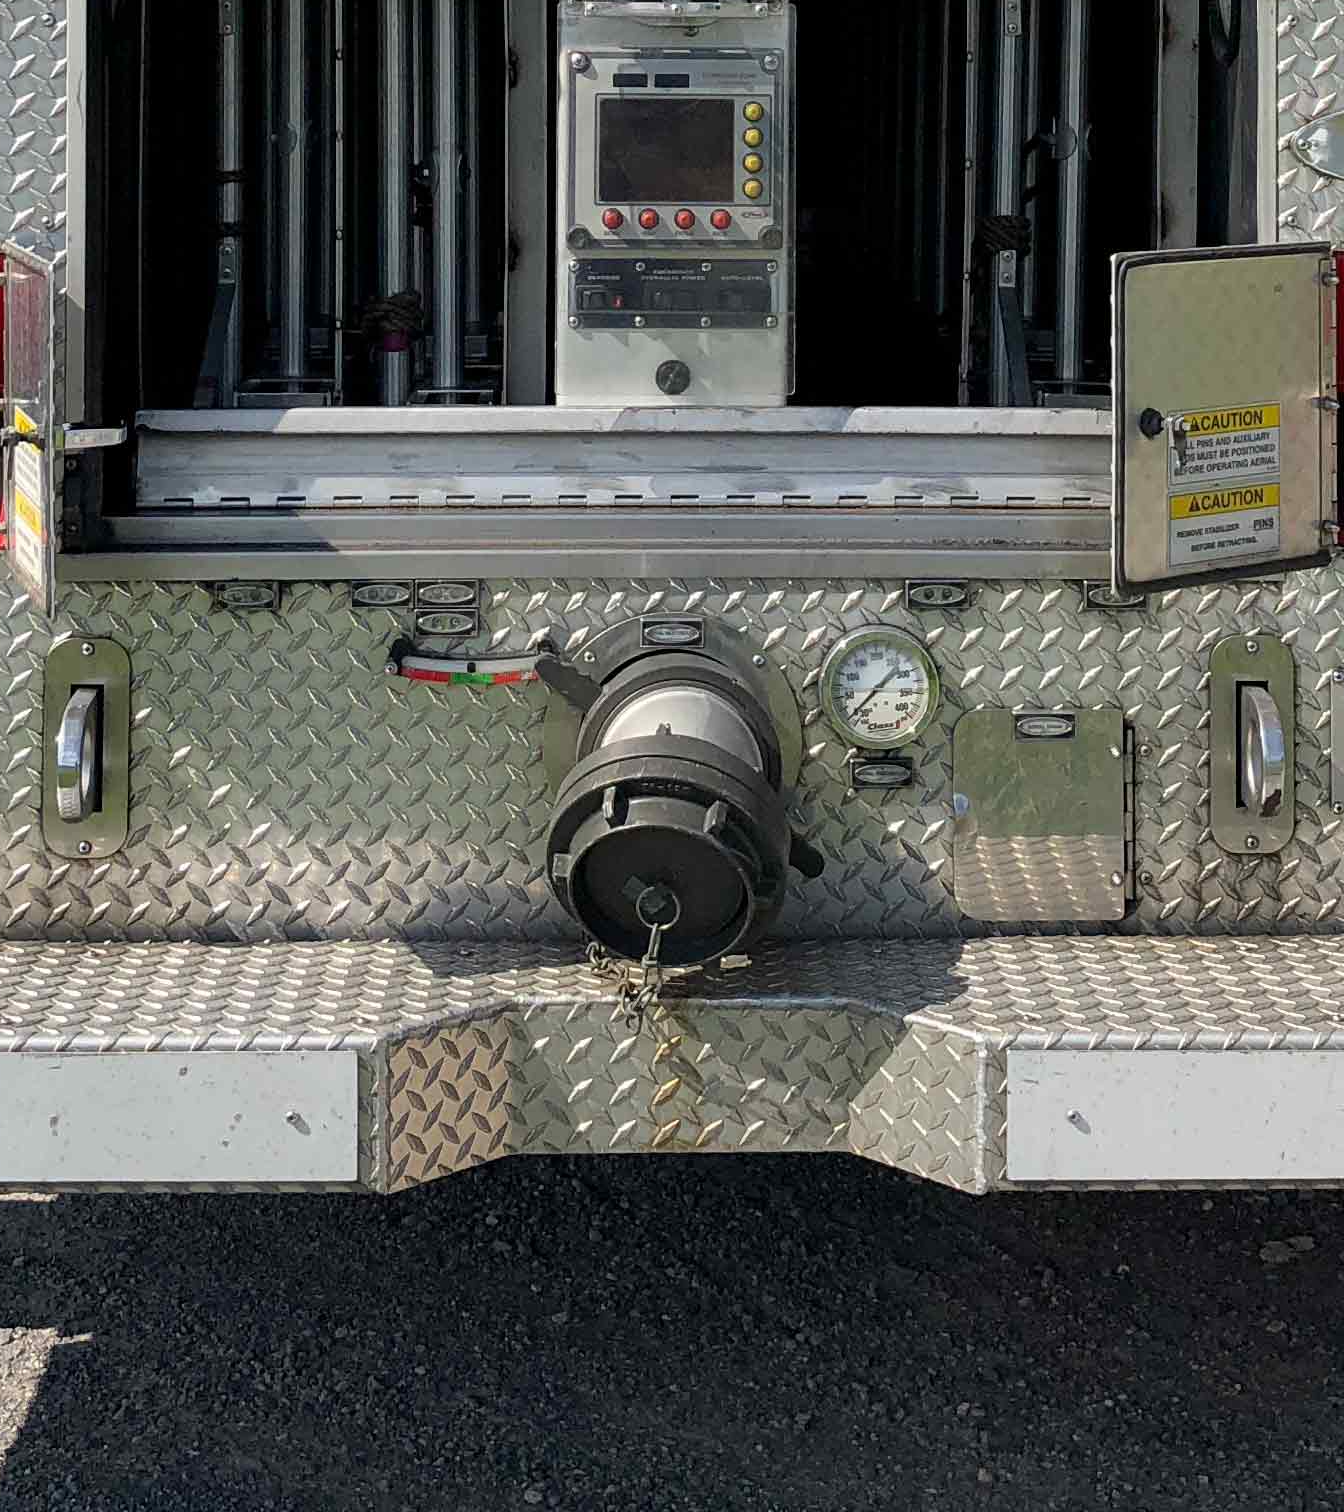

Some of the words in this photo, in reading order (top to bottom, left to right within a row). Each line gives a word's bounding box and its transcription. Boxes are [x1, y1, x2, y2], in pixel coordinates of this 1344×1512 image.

[1201, 410, 1263, 431] CAUTION
[1197, 451, 1217, 460] MUST
[1220, 449, 1229, 458] BE
[1207, 458, 1248, 472] OPERATING
[1201, 488, 1264, 510] CAUTION
[1253, 517, 1274, 529] PINS
[896, 702, 909, 712] 400
